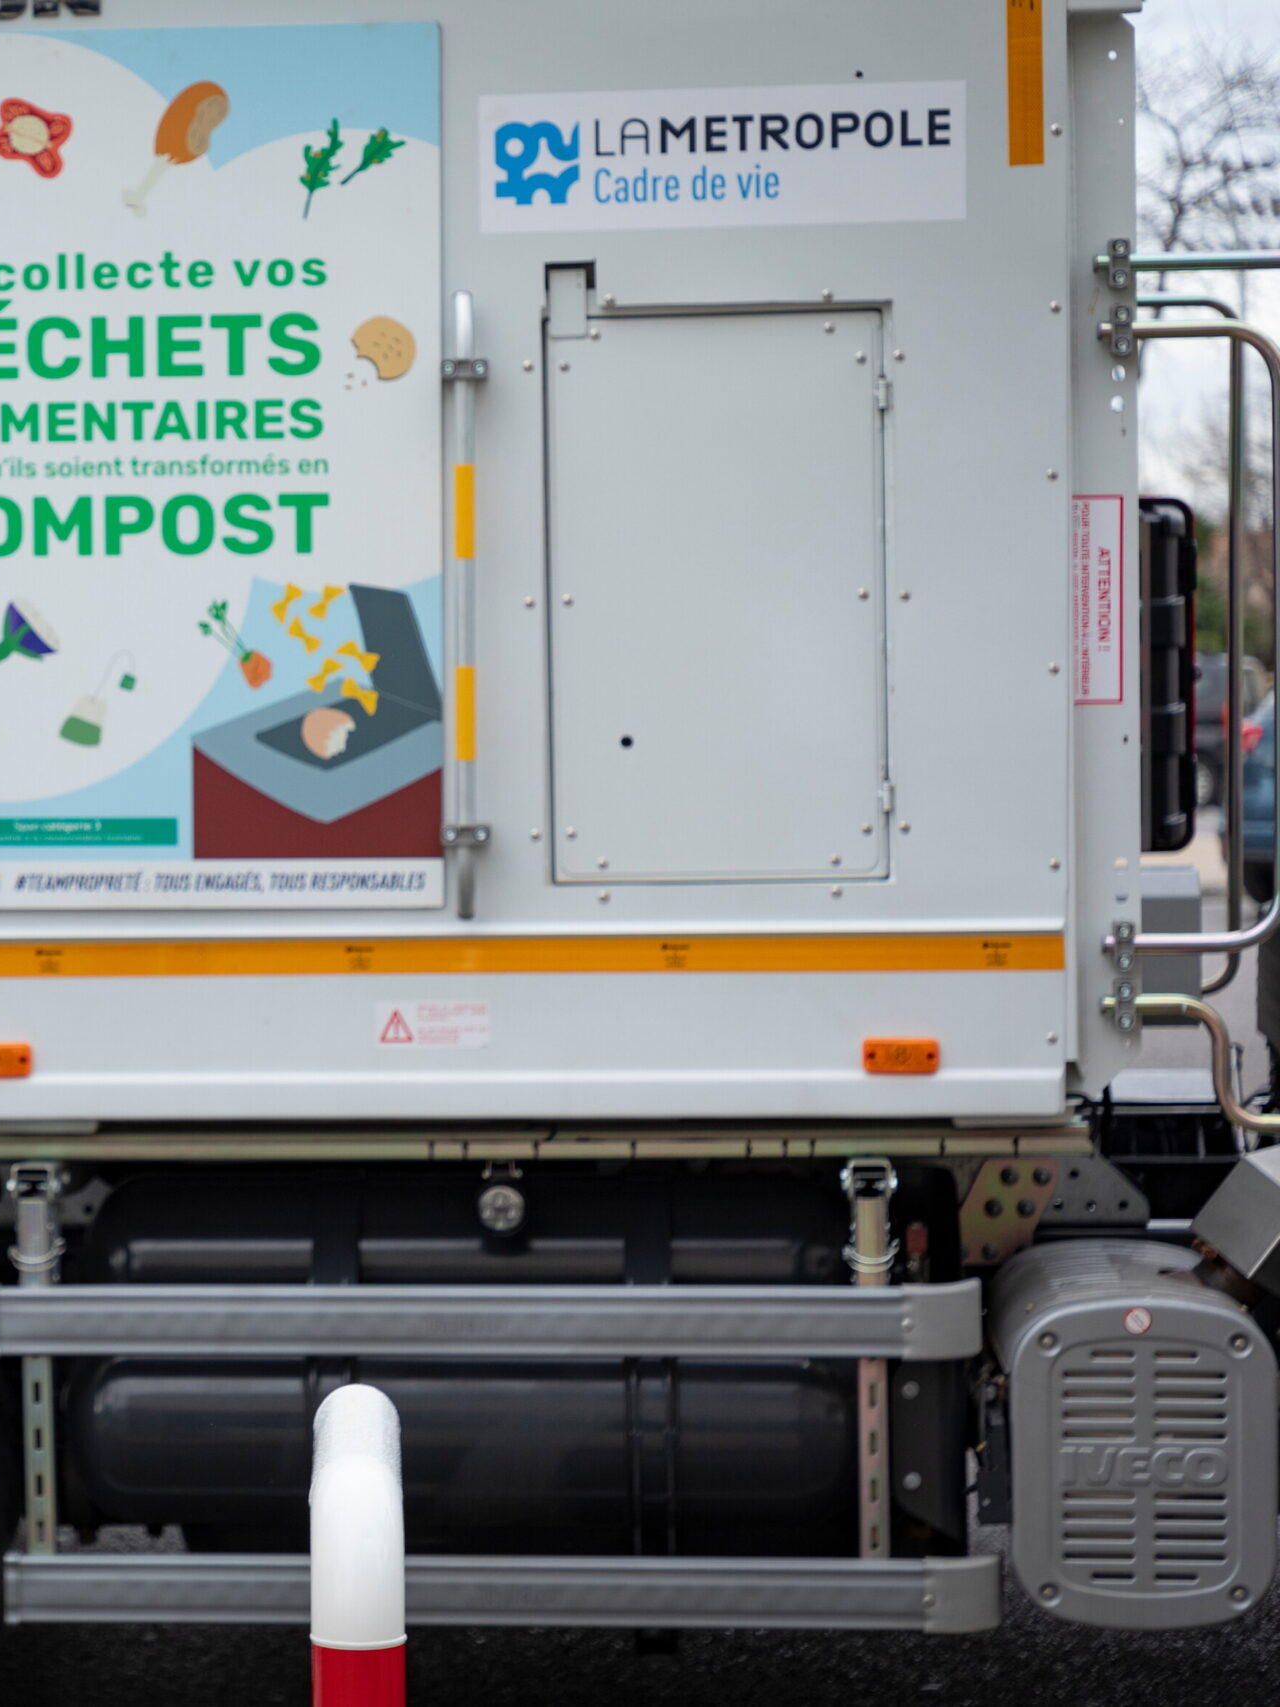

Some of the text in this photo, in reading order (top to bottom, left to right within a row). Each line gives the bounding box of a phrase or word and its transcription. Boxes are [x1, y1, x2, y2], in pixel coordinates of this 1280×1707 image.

[594, 165, 780, 204] Cadre de vie
[233, 258, 327, 287] vos
[44, 457, 123, 478] soient
[131, 454, 290, 478] transformés
[298, 458, 329, 475] en
[1098, 546, 1111, 642] ATTENTION
[14, 869, 144, 892] #TEAMPROPRETÉ
[153, 872, 192, 891] TOUS
[194, 869, 265, 894] ENGAGÉS,
[269, 871, 305, 891] TOUS
[308, 871, 427, 891] RESPONSABLES
[1060, 1447, 1229, 1487] IVECO
